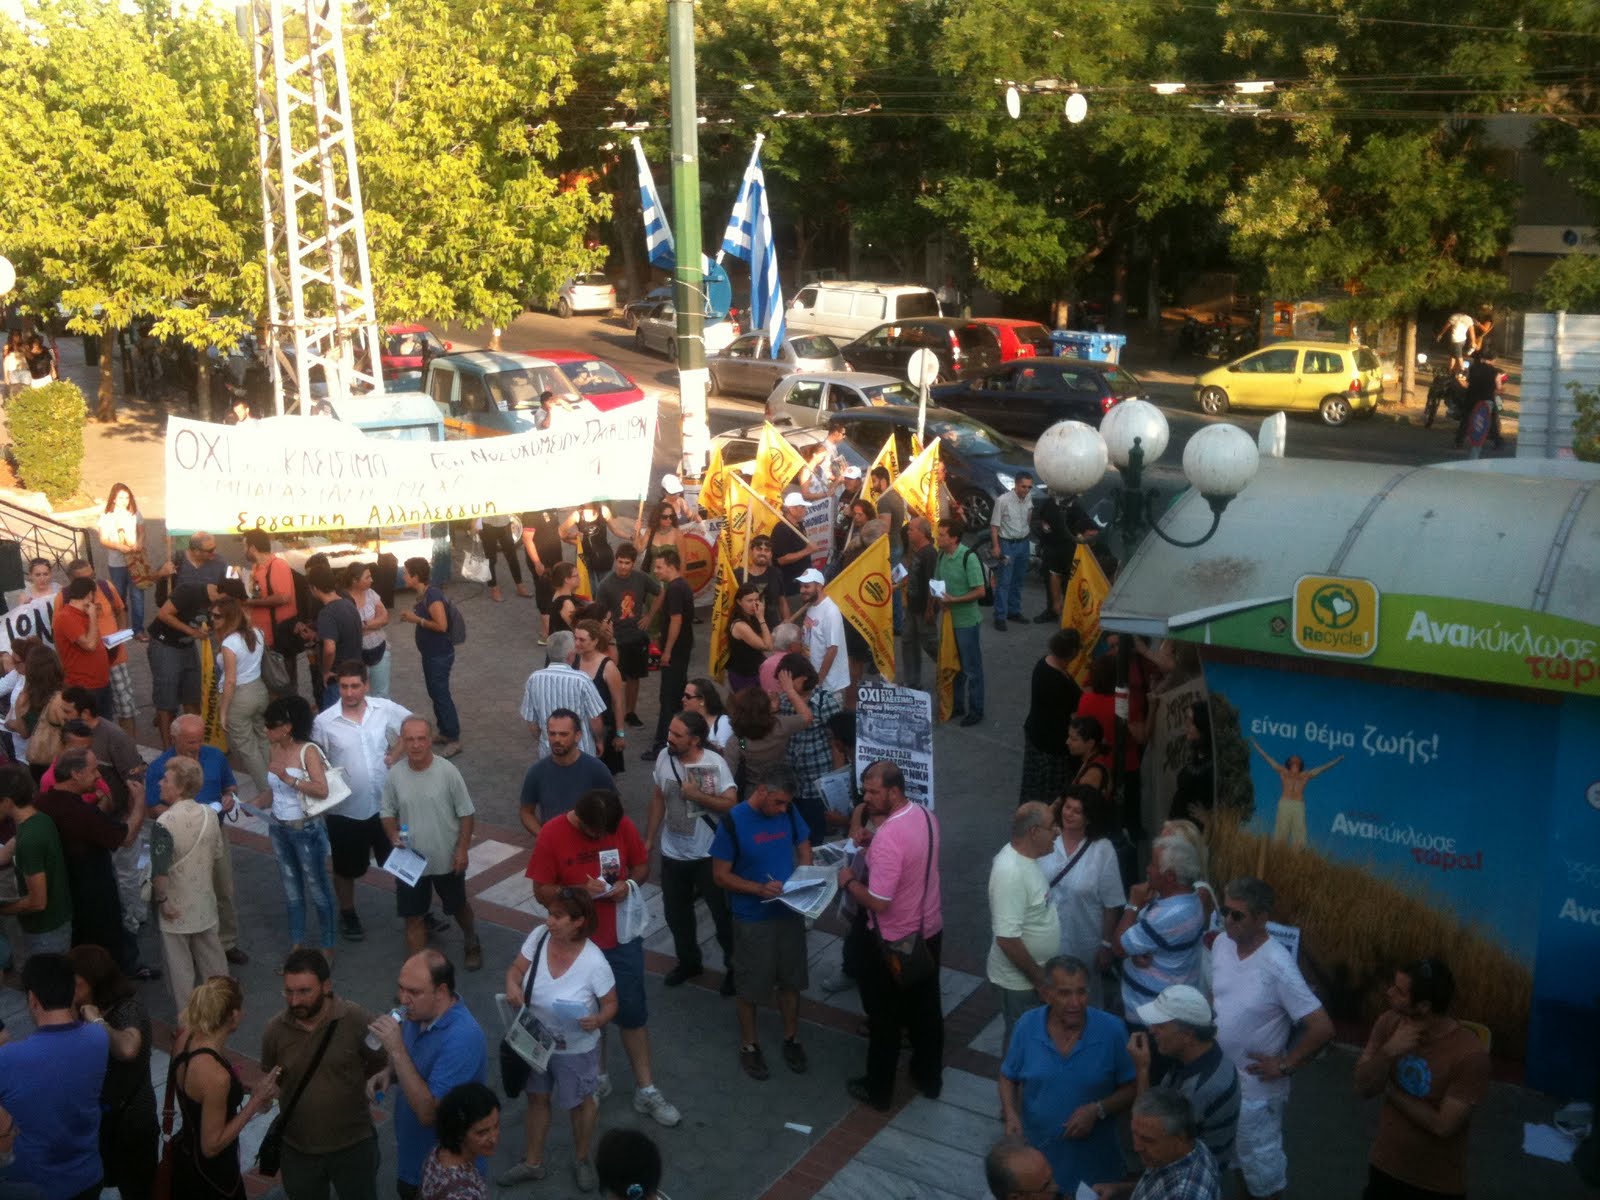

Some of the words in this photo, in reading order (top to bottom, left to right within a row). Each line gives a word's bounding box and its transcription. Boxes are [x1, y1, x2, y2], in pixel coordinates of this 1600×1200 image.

[174, 428, 232, 473] ΟΧΙ
[1302, 625, 1370, 649] Recycle!
[1406, 610, 1598, 662] Ανακύκλωσε
[1524, 652, 1600, 689] τώρ
[858, 687, 880, 702] ΟΧΙ
[1251, 715, 1298, 740] είναι
[1304, 721, 1355, 751] θέμα
[1362, 723, 1440, 764] ζωής!
[1331, 812, 1456, 854] Ανακύκλωσε
